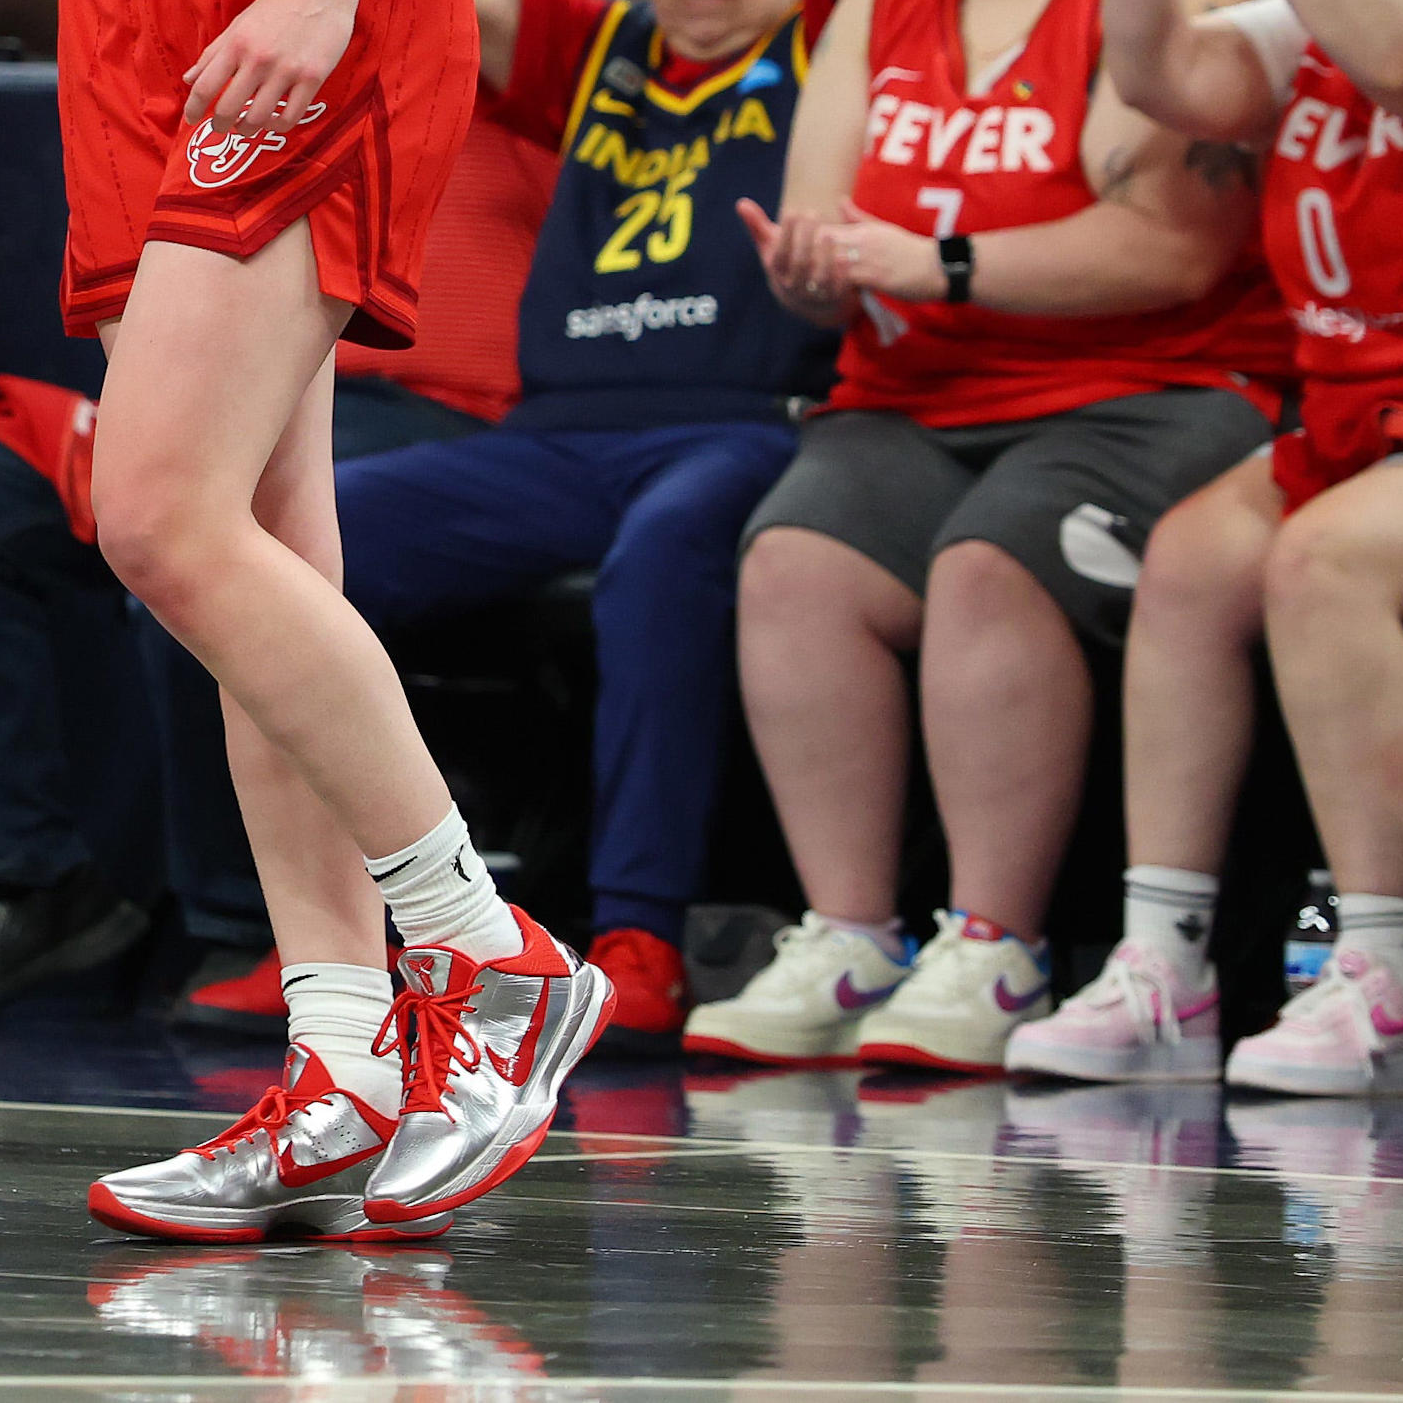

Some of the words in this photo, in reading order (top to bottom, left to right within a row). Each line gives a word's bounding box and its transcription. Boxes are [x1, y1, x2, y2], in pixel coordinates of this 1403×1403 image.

[865, 94, 1056, 176] FEVER
[594, 168, 696, 274] 25
[1297, 186, 1351, 298] 0
